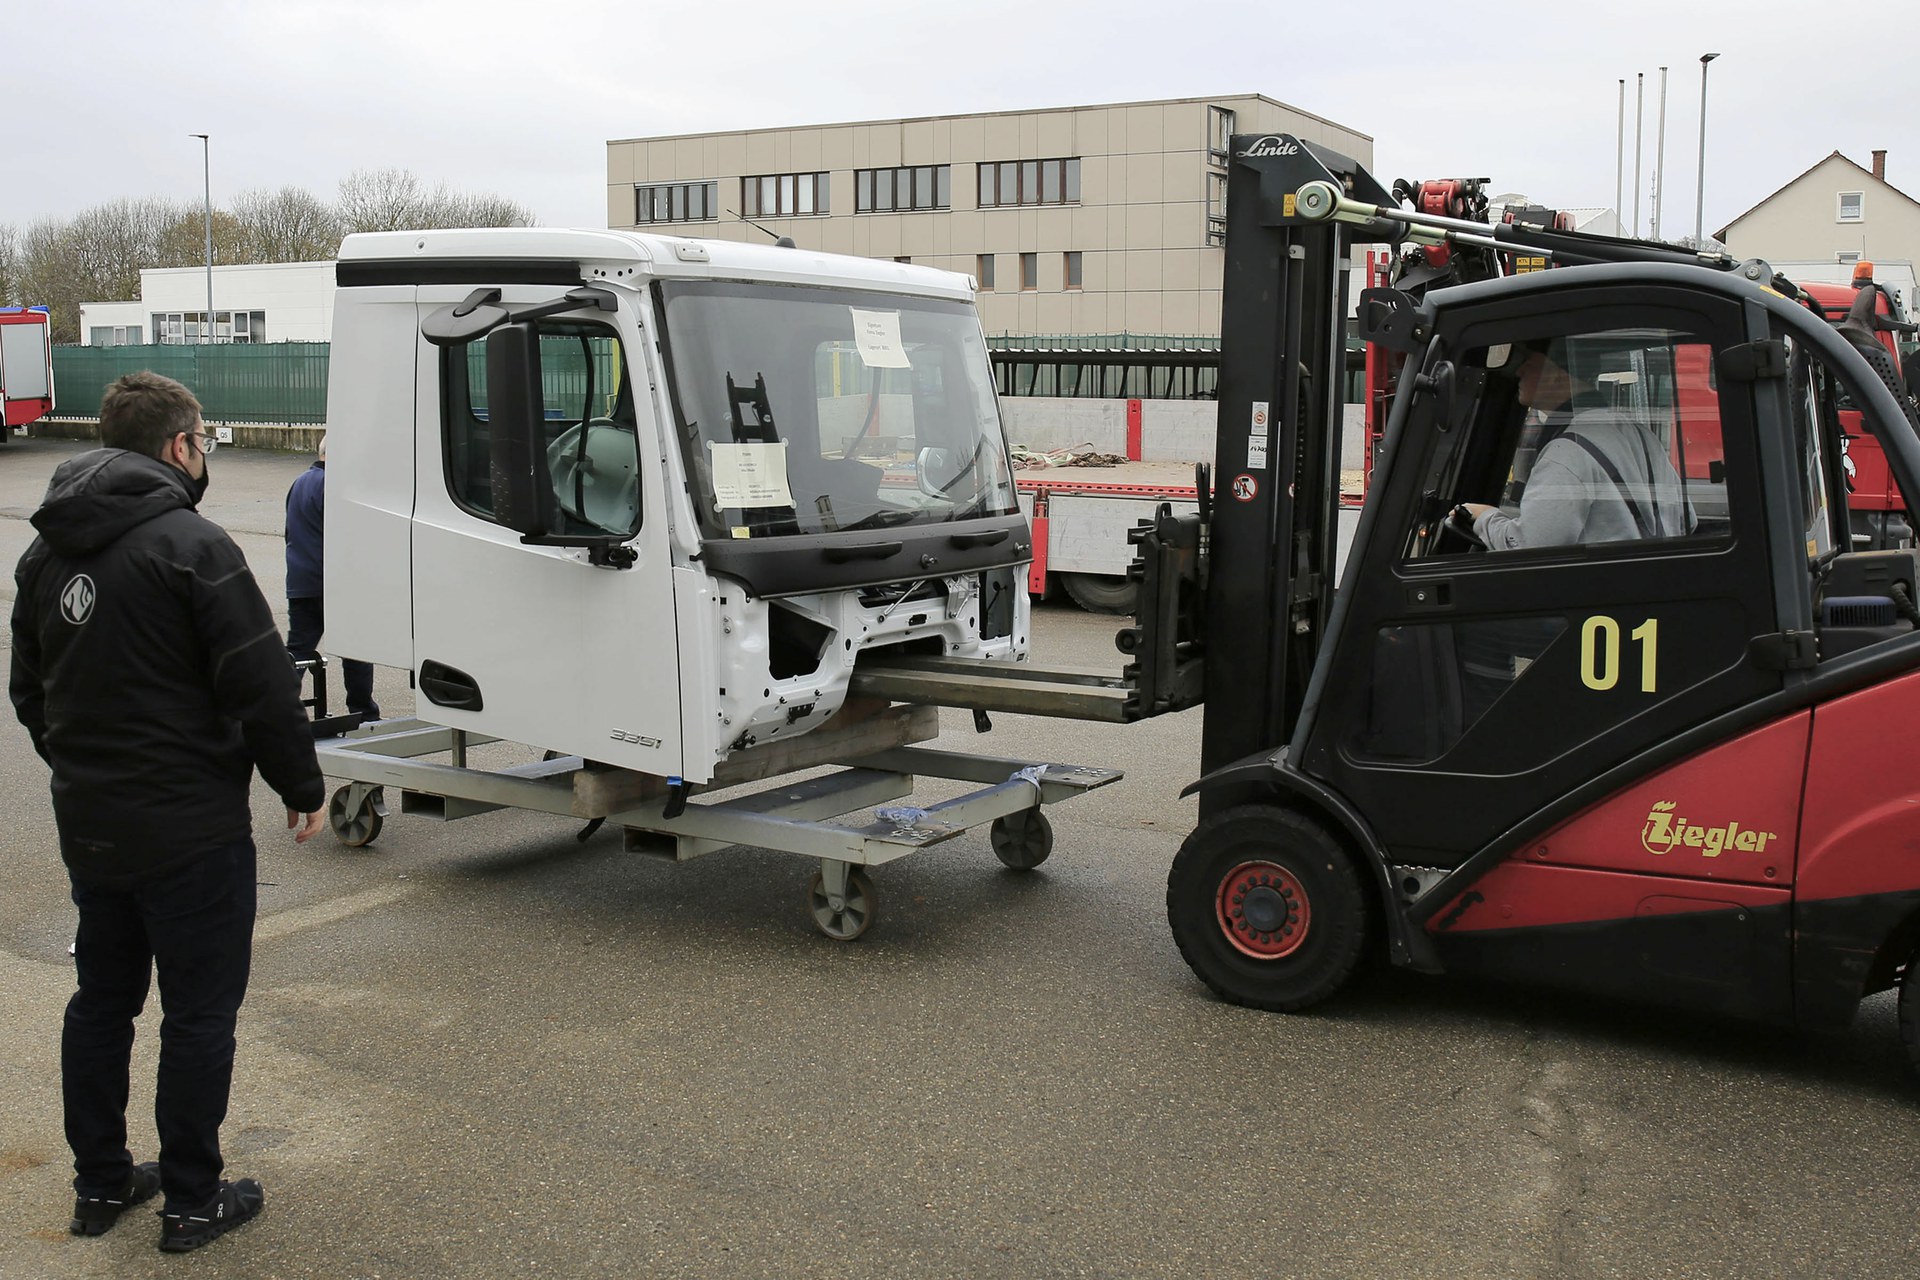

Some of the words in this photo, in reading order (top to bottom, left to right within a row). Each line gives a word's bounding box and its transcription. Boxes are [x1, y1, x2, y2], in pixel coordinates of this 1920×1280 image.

[1236, 136, 1298, 157] Linde
[1581, 615, 1657, 692] 01
[1645, 808, 1777, 857] Ziegler
